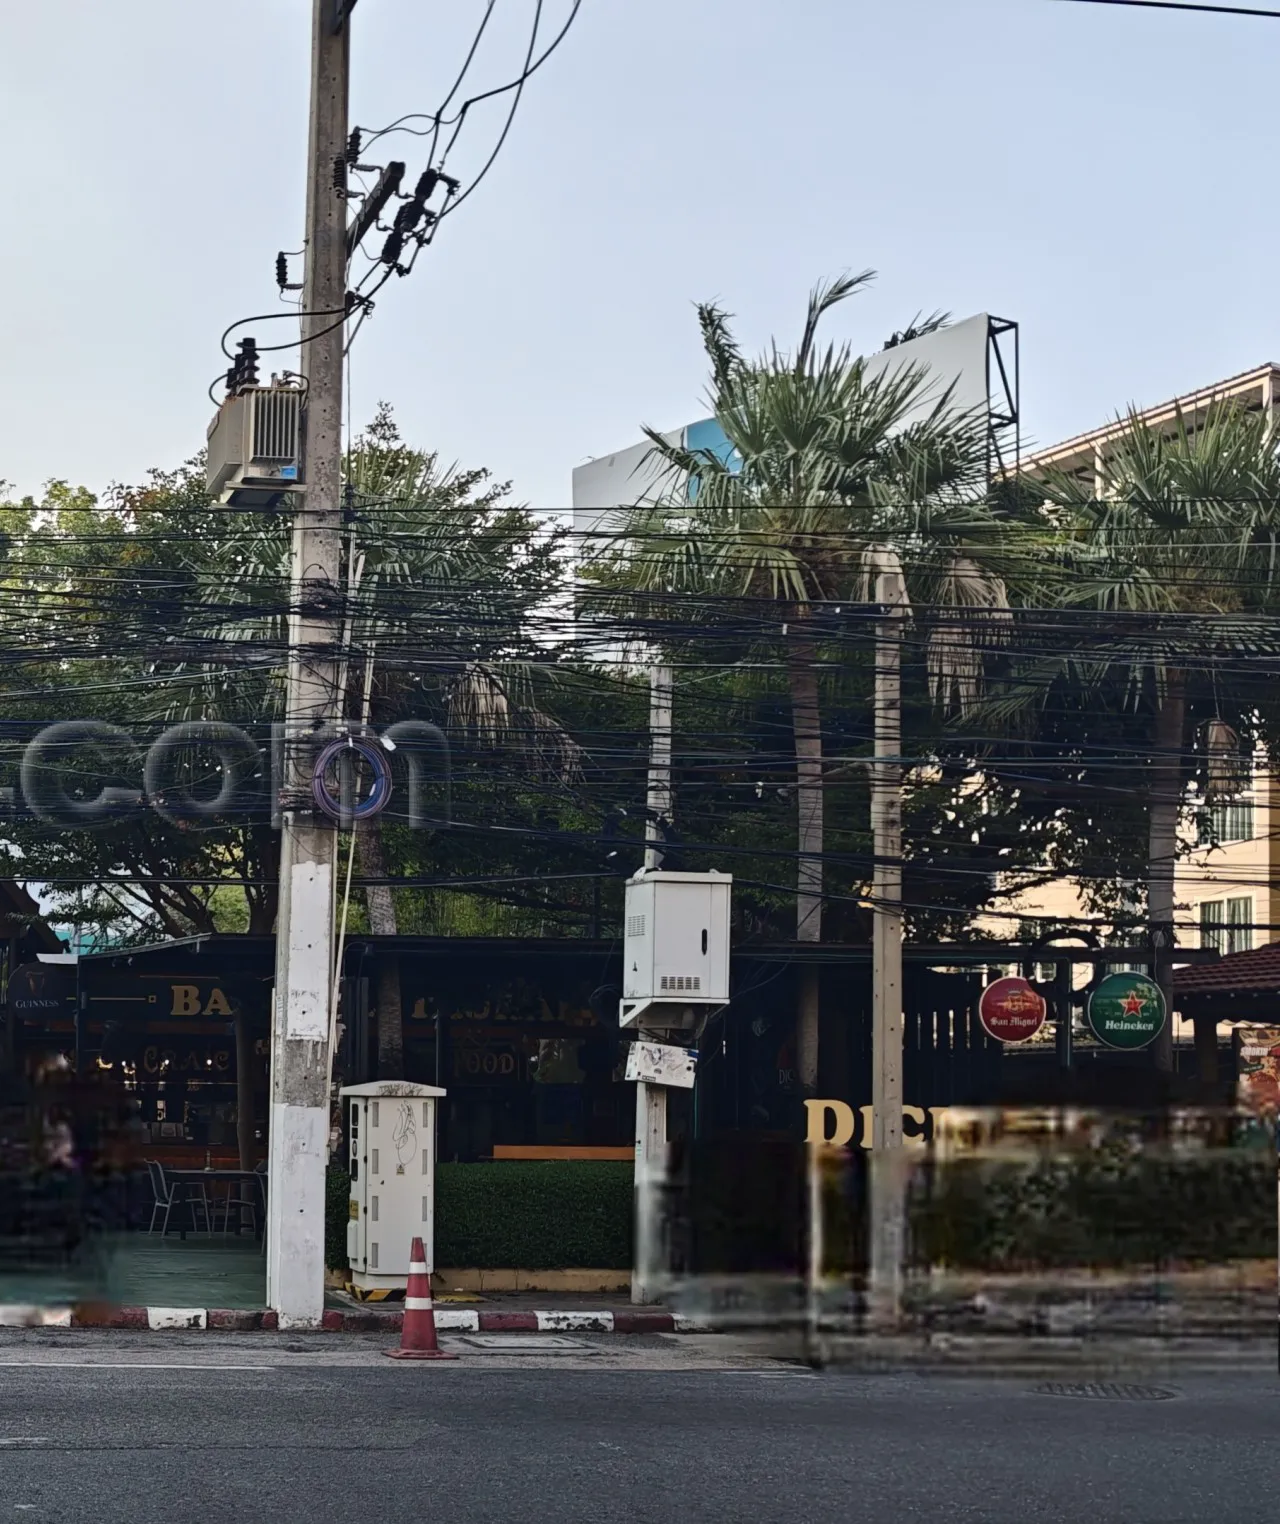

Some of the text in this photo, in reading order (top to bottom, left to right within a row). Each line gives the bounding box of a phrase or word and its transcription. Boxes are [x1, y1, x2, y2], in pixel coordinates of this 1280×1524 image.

[15, 998, 60, 1009] GUINNESS
[169, 984, 234, 1017] BA
[989, 1015, 1038, 1029] San Miguel
[1104, 1018, 1154, 1032] Heineken
